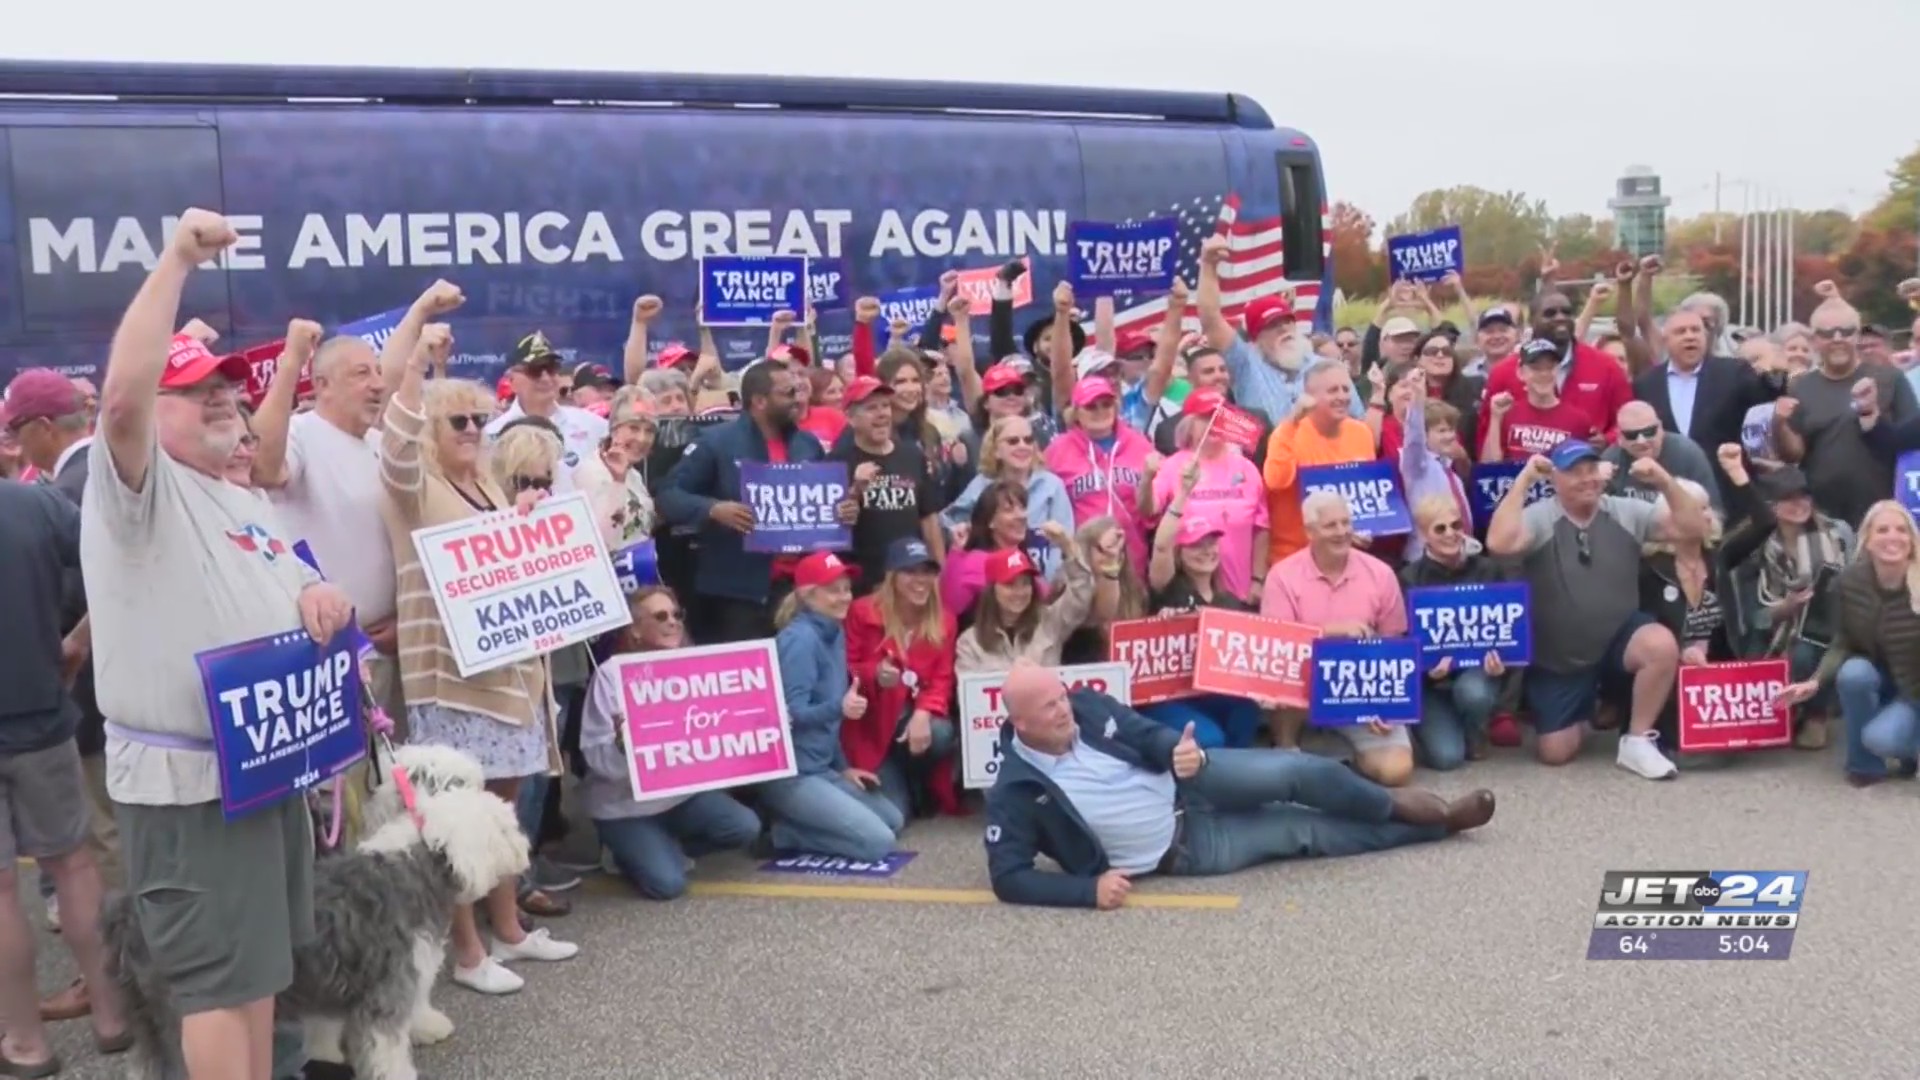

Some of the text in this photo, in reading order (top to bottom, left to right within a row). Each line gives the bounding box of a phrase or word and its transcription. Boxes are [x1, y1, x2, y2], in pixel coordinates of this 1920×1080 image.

[287, 211, 624, 268] AMERICA
[641, 209, 852, 262] GREAT
[869, 208, 1067, 258] AGAIN!
[1076, 237, 1172, 259] TRUMP
[1392, 239, 1457, 261] TRUMP
[1087, 256, 1162, 273] VANCE
[713, 270, 796, 287] TRUMP
[722, 286, 786, 301] VANCE
[1513, 427, 1566, 445] TRUMP
[746, 483, 844, 506] TRUMP
[1074, 467, 1142, 498] BOTON
[863, 487, 916, 508] PAPA
[754, 503, 835, 523] VANCE
[443, 513, 574, 573] TRUMP
[445, 565, 520, 598] SECURE
[522, 543, 597, 577] BORDER
[475, 579, 592, 631] KAMALA
[1415, 603, 1524, 629] TRUMP
[477, 600, 606, 653] OPEN BORDER
[1428, 624, 1513, 644] VANCE
[534, 633, 565, 651] 2024
[1206, 628, 1313, 662] TRUMP
[1216, 649, 1301, 679] VANCE
[1318, 659, 1416, 681] TRUMP
[219, 650, 351, 727] TRUMP
[629, 667, 767, 706] WOMEN
[1329, 679, 1406, 697] VANCE
[1684, 680, 1784, 706] TRUMP
[246, 690, 344, 753] VANCE
[684, 704, 728, 735] for
[973, 715, 1005, 730] SEC
[1696, 701, 1774, 722] VANCE
[635, 727, 781, 771] TRUMP
